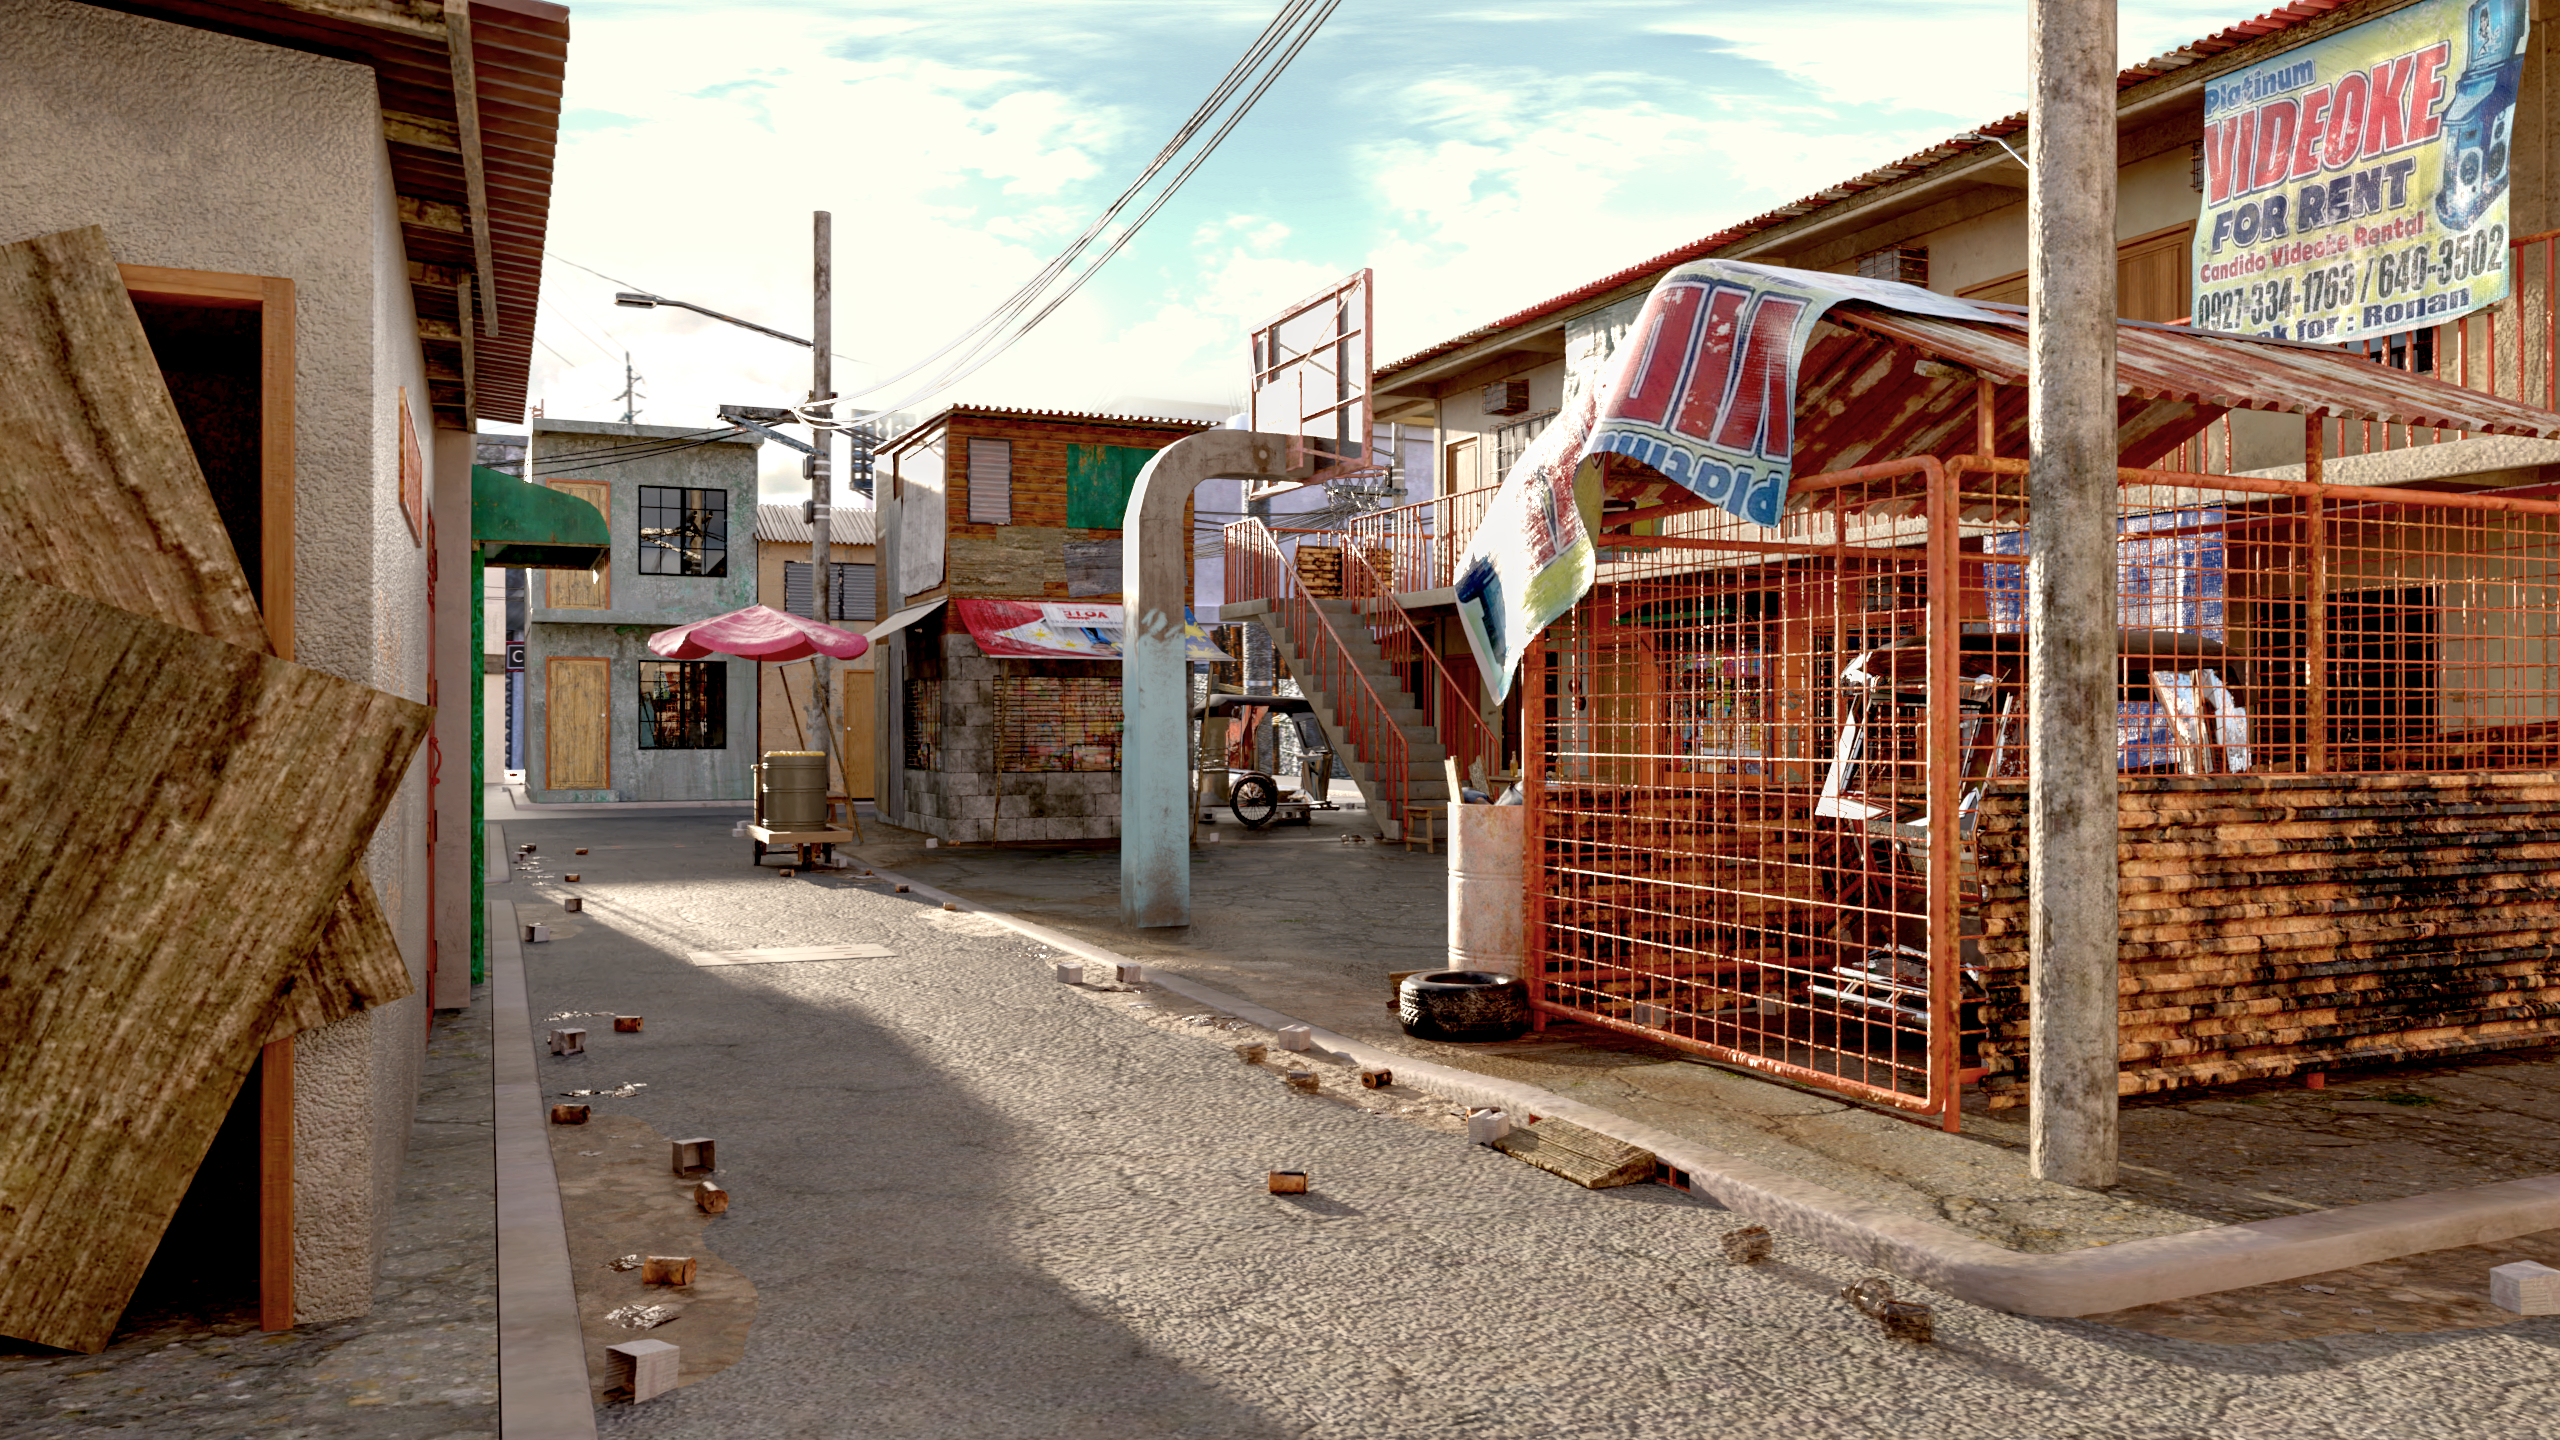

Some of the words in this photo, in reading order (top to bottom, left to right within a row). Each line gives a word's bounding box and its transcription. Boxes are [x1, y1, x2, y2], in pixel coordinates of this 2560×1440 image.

[2204, 41, 2449, 208] VIDEOKE
[2205, 59, 2315, 117] Platinum
[2212, 194, 2289, 254] FOR
[2297, 156, 2415, 233] RENT
[2198, 263, 2355, 330] 0927-334-1763
[2378, 223, 2505, 299] 640-3502
[2200, 252, 2266, 283] Candido
[2271, 234, 2349, 268] Videoke
[2354, 210, 2424, 247] Rental
[2363, 287, 2470, 328] Ronan
[512, 650, 524, 662] C
